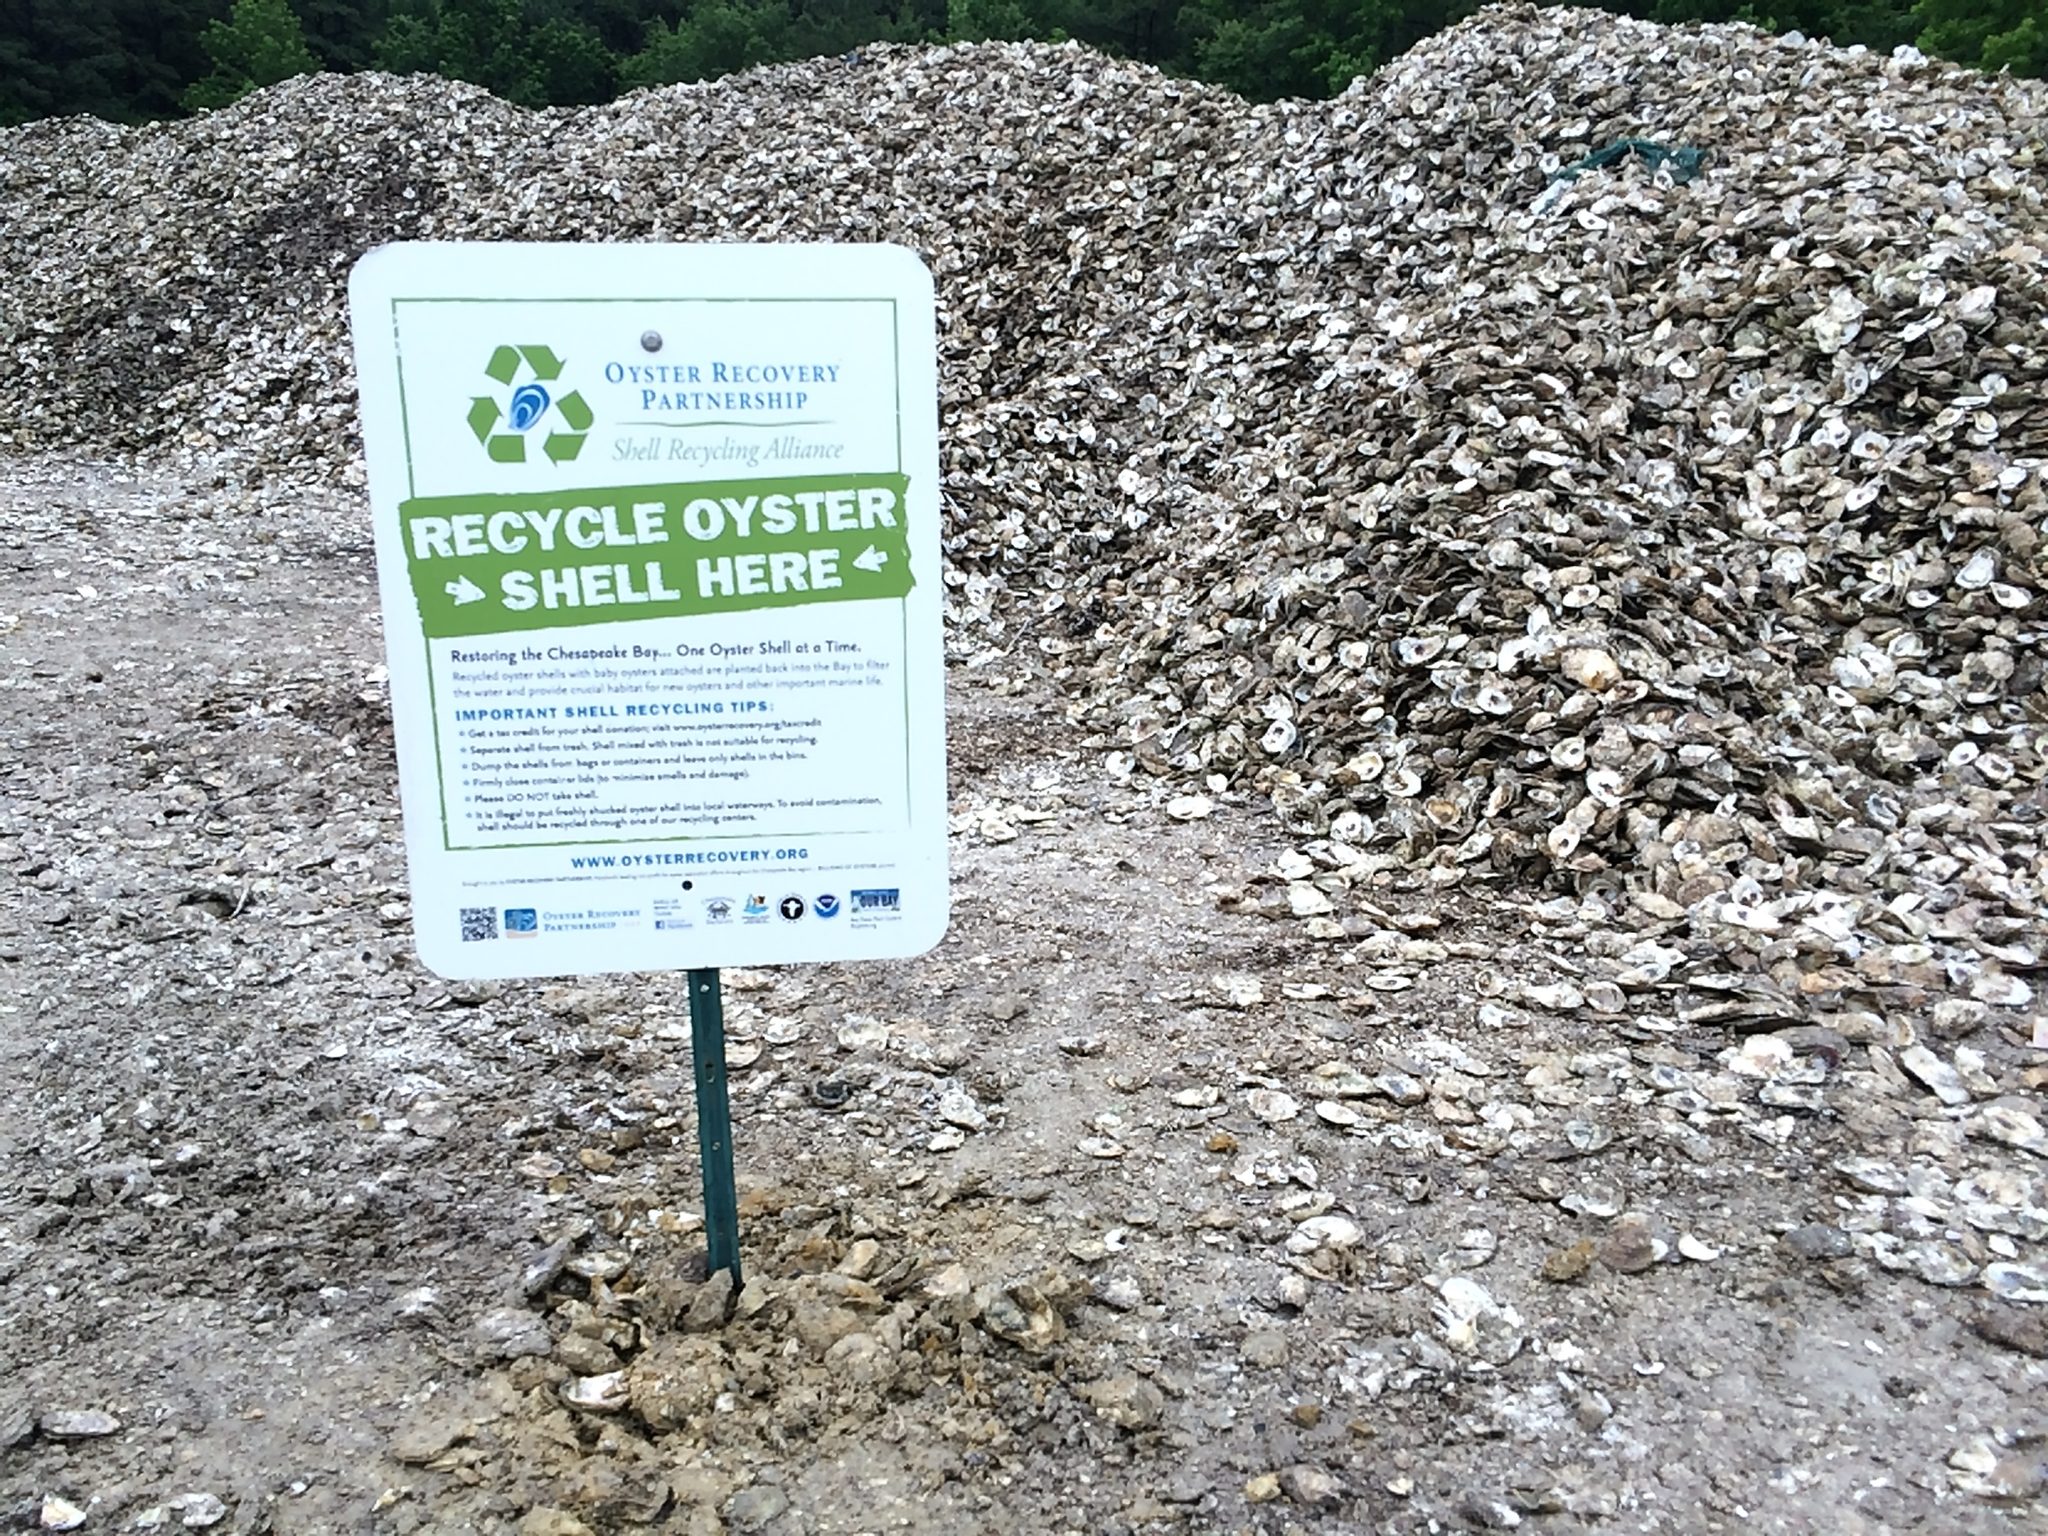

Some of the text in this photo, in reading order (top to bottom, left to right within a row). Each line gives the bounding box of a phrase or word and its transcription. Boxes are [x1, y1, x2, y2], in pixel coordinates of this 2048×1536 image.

[613, 436, 844, 466] Shell Recycling Alliance
[408, 489, 901, 558] RECYCLE OYSTER
[502, 550, 842, 610] SHELL HERE
[451, 650, 517, 665] Restoring
[522, 647, 543, 660] the
[547, 646, 628, 660] Chesapeake
[676, 644, 705, 656] One
[710, 643, 754, 659] Oyster
[759, 640, 791, 654] Shell
[796, 643, 809, 653] at
[826, 640, 861, 652] Time.
[455, 708, 557, 721] IMPORTANT
[564, 706, 619, 717] SHELL
[625, 703, 724, 716] RECYCLING
